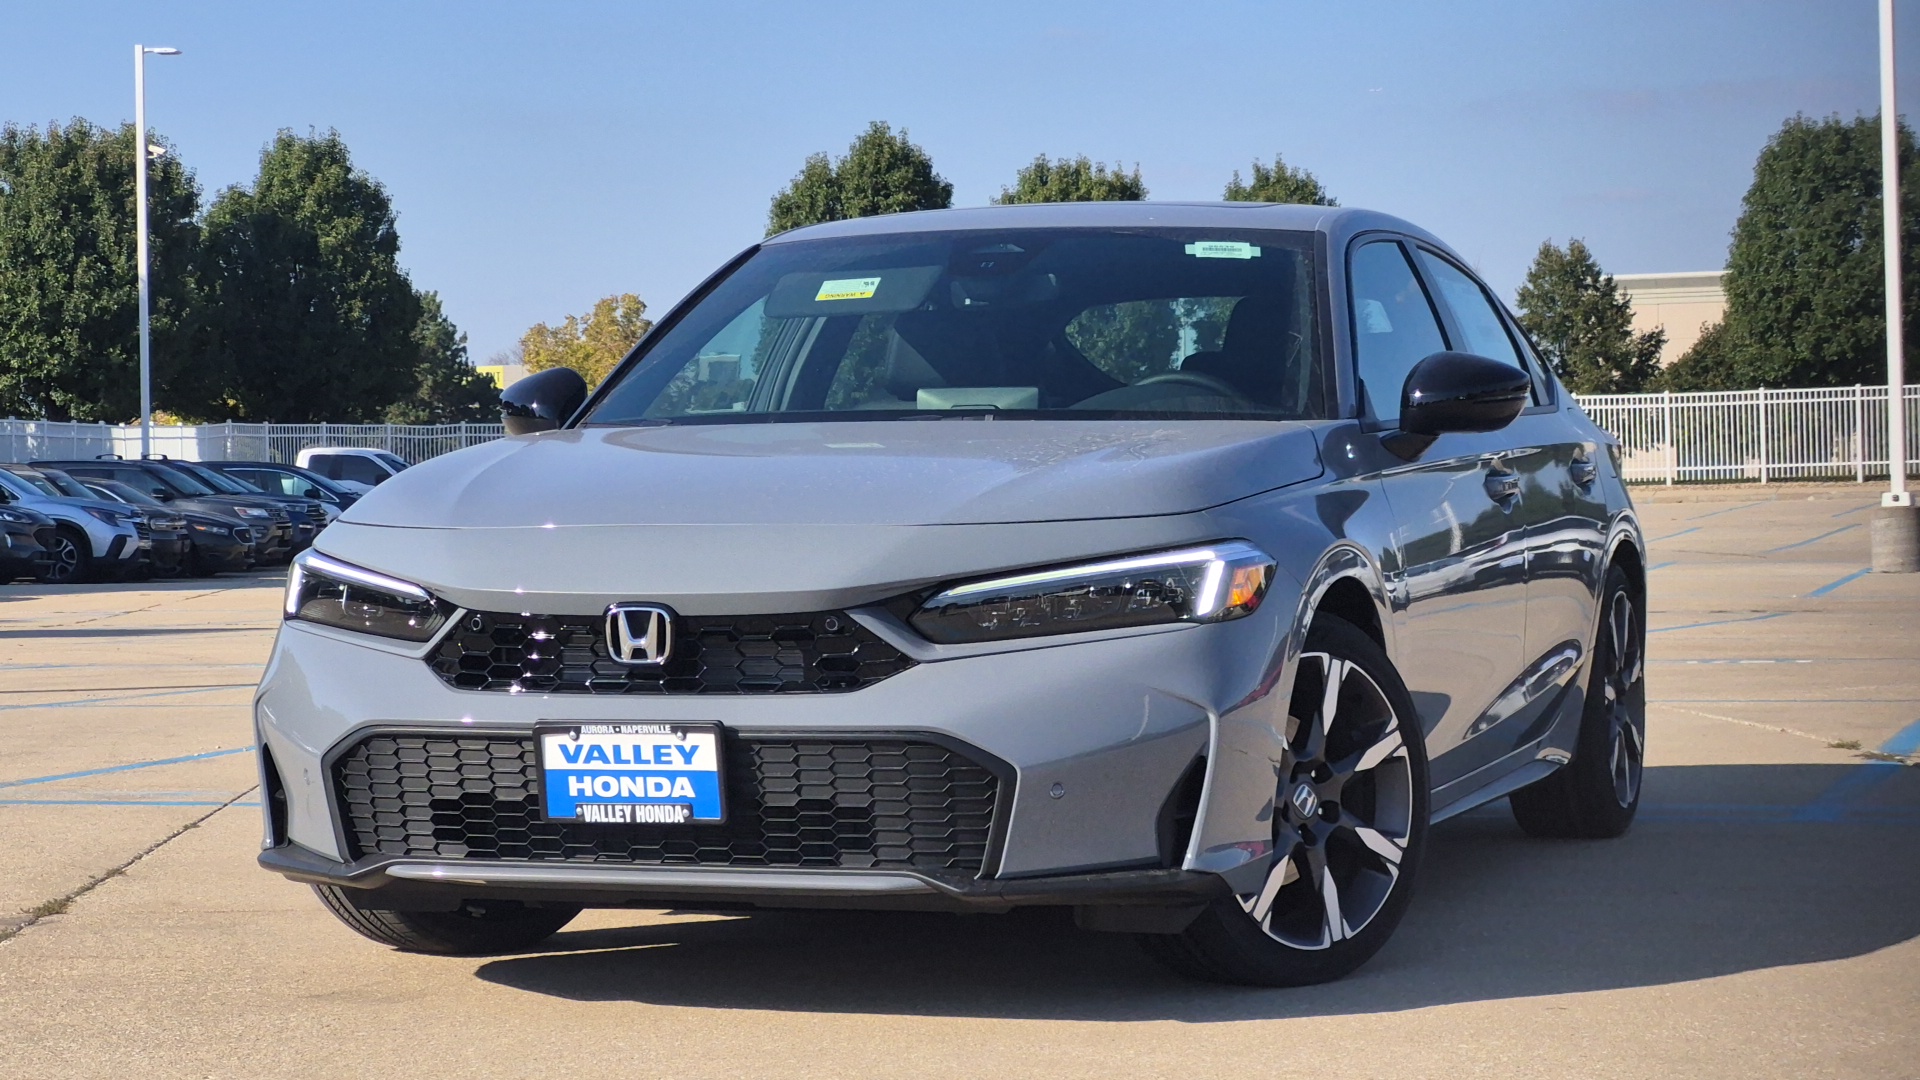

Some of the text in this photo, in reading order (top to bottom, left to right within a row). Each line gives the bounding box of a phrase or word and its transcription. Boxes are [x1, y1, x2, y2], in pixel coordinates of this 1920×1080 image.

[581, 725, 671, 734] AURORA NAPERVILLE
[558, 744, 700, 765] VALLEY
[568, 775, 696, 798] HONDA
[583, 804, 684, 823] VALLEY HONDA
